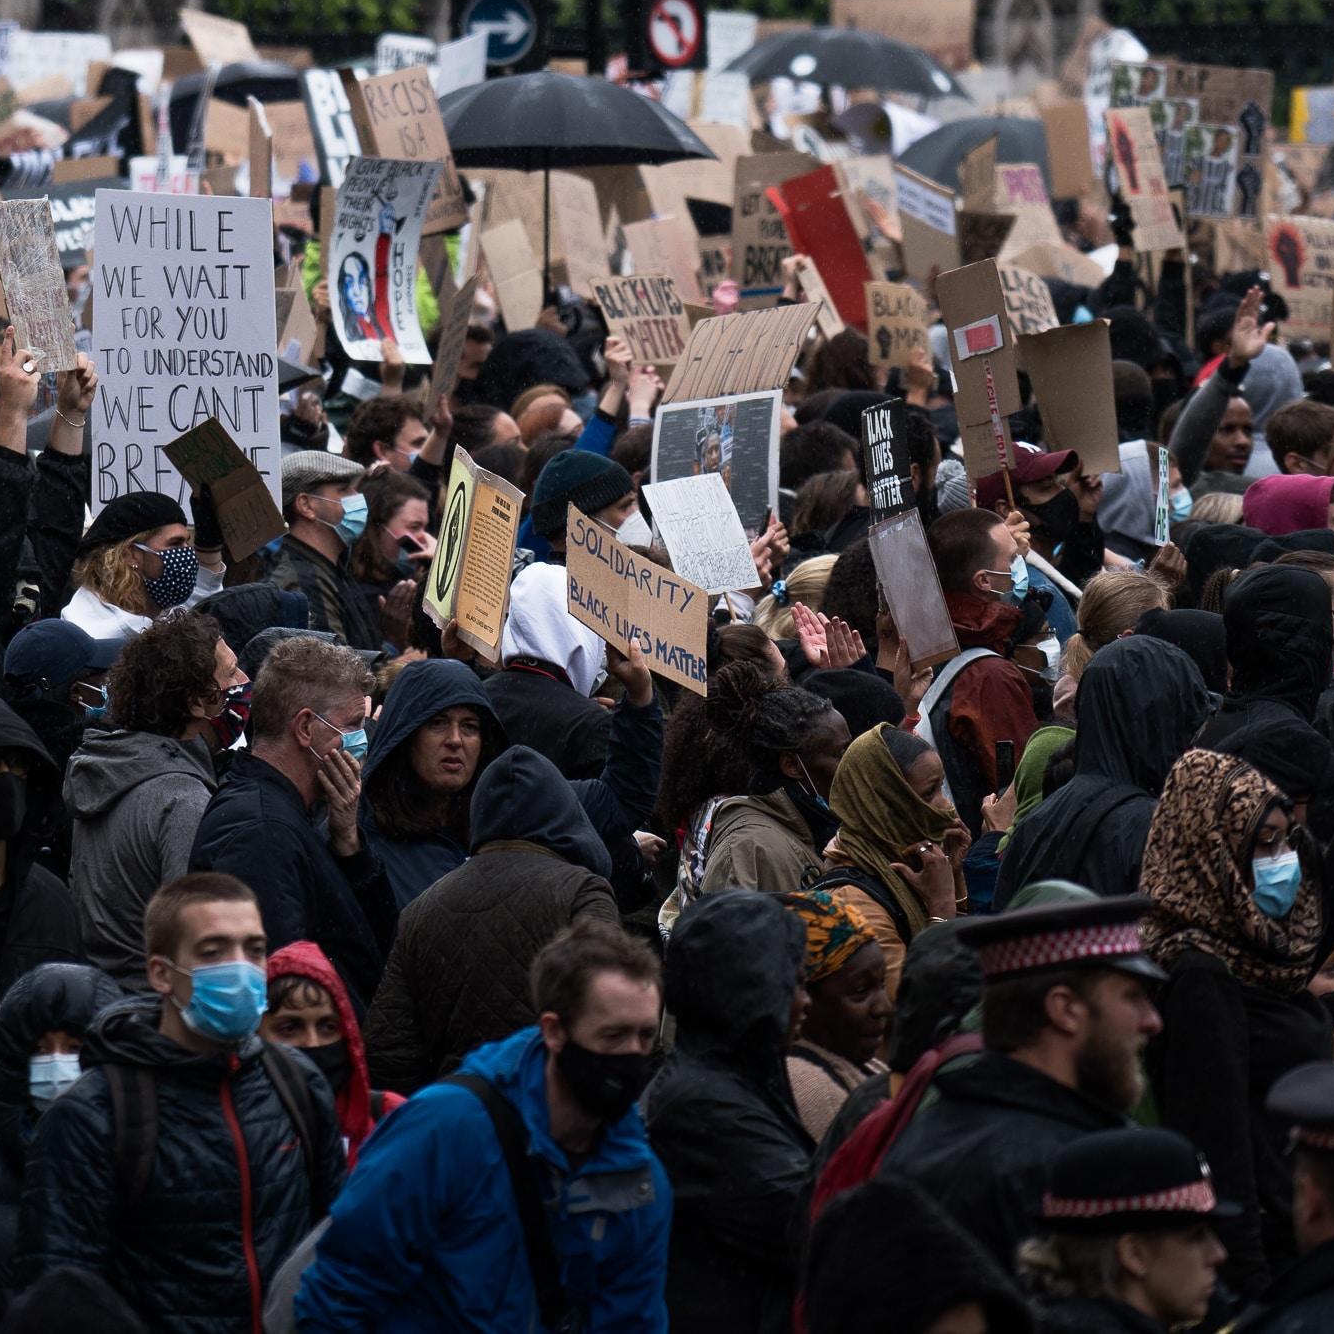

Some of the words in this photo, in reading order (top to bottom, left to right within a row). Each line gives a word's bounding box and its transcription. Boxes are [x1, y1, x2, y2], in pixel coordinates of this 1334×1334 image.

[364, 80, 433, 124] RACISM
[388, 162, 424, 180] BLACK
[342, 196, 373, 213] THEIR
[110, 203, 234, 254] WHILE
[337, 216, 376, 234] RIGHTS
[101, 263, 144, 300] WE
[163, 263, 251, 301] WAIT
[594, 282, 641, 319] BLACK
[645, 277, 684, 316] LIVES
[121, 305, 166, 341] FOR
[175, 304, 229, 342] YOU
[872, 290, 924, 318] BLAC
[624, 318, 685, 361] MATTER
[99, 347, 133, 375] TO
[143, 347, 274, 379] UNDERSTAND.
[100, 384, 158, 434] WE
[168, 383, 265, 434] CAN'T
[866, 409, 894, 448] BLACK
[97, 442, 272, 506] BREE
[870, 439, 894, 477] LIVES
[570, 517, 696, 614] SOLIDARITY
[568, 574, 612, 629] BLACK
[615, 611, 653, 656] LIVES
[654, 641, 708, 684] MATTER
